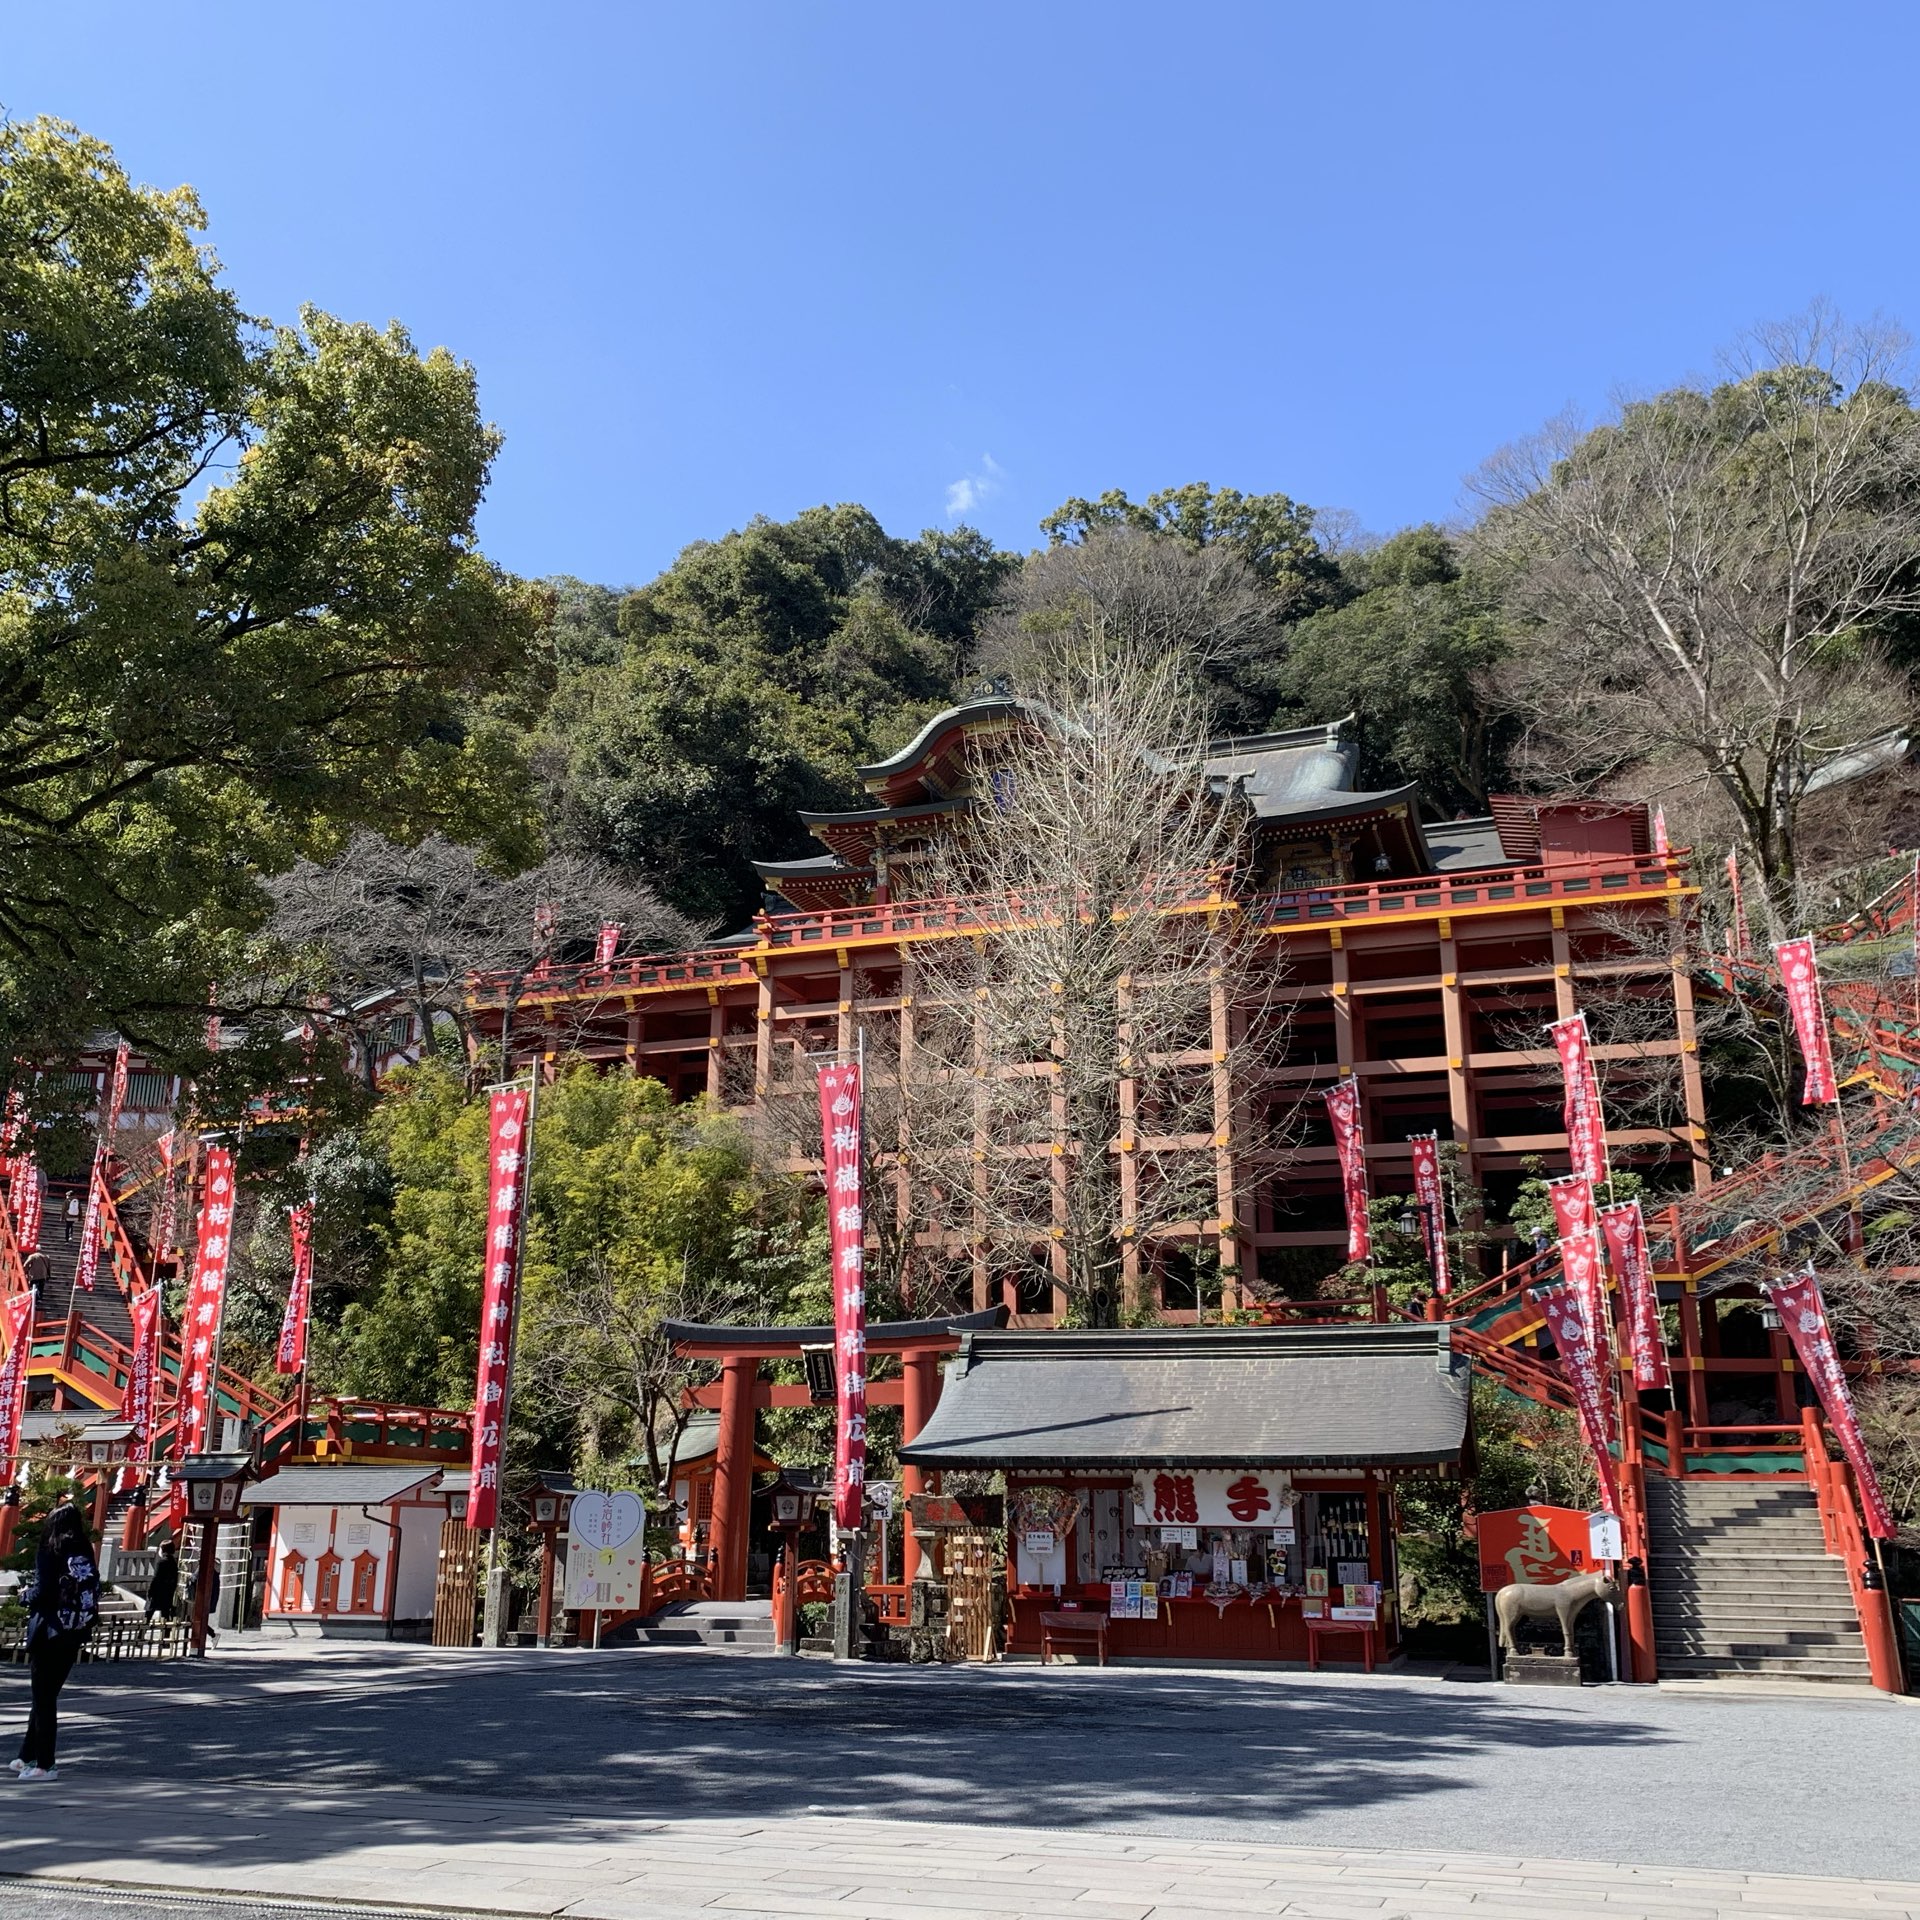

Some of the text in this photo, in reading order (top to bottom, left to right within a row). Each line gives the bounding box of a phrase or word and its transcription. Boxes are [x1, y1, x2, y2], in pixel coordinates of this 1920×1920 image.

[478, 1147, 521, 1490] 祐徳稲荷神社御広前
[831, 1125, 867, 1487] 祐徳稲荷神社御広前
[1152, 1473, 1272, 1524] 熊手
[1599, 1515, 1612, 1558] 下り参道
